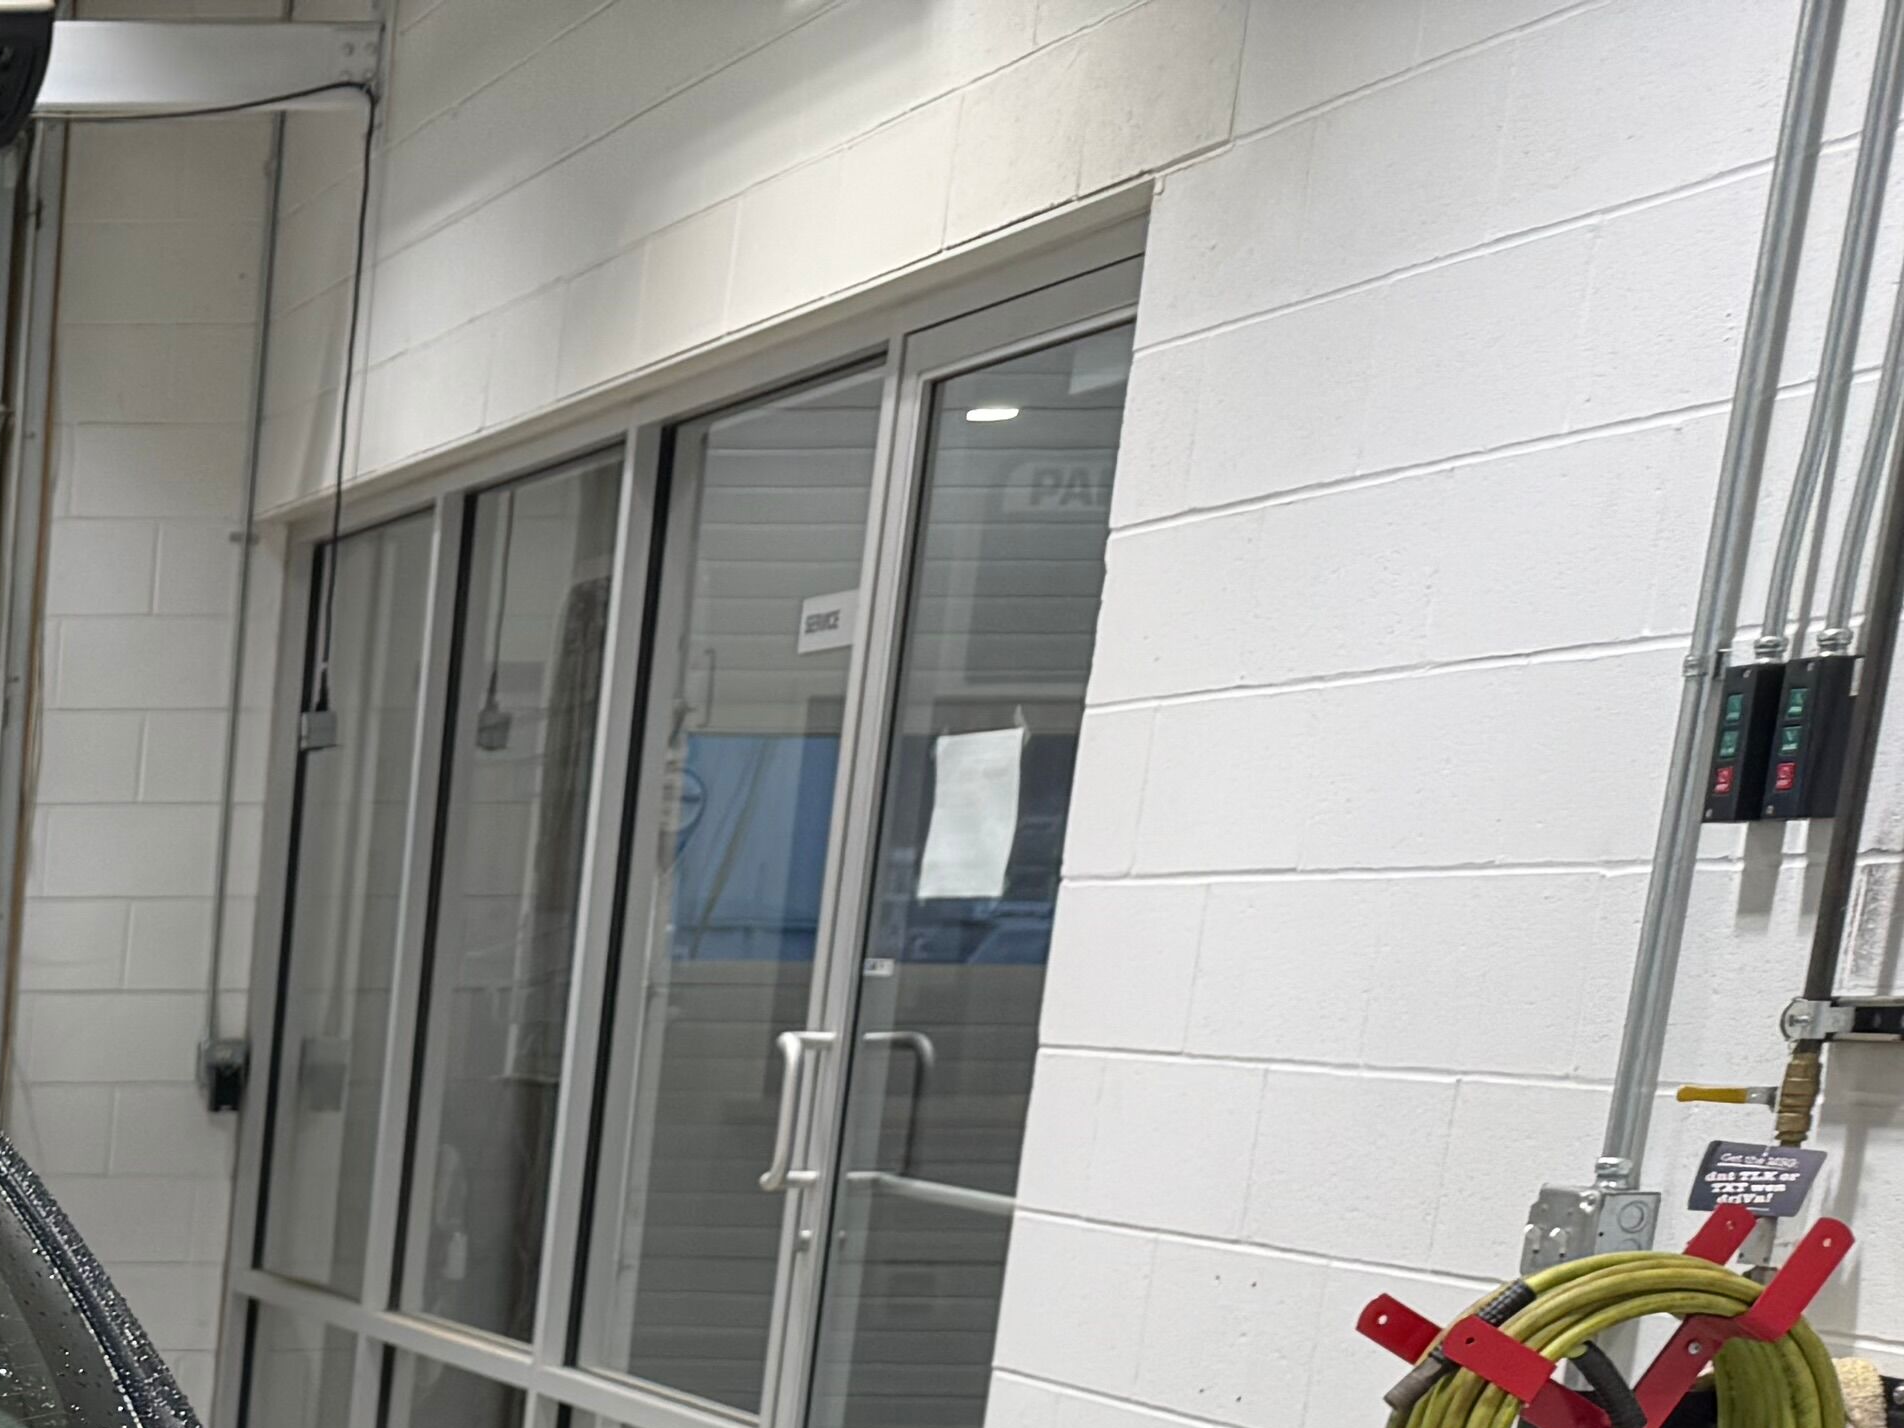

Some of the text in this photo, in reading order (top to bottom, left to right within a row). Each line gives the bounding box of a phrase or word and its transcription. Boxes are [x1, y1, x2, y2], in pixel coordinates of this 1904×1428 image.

[804, 608, 841, 634] SERVICE
[1739, 1171, 1779, 1182] TLK
[1779, 1172, 1800, 1182] or
[1711, 1182, 1749, 1193] TXT
